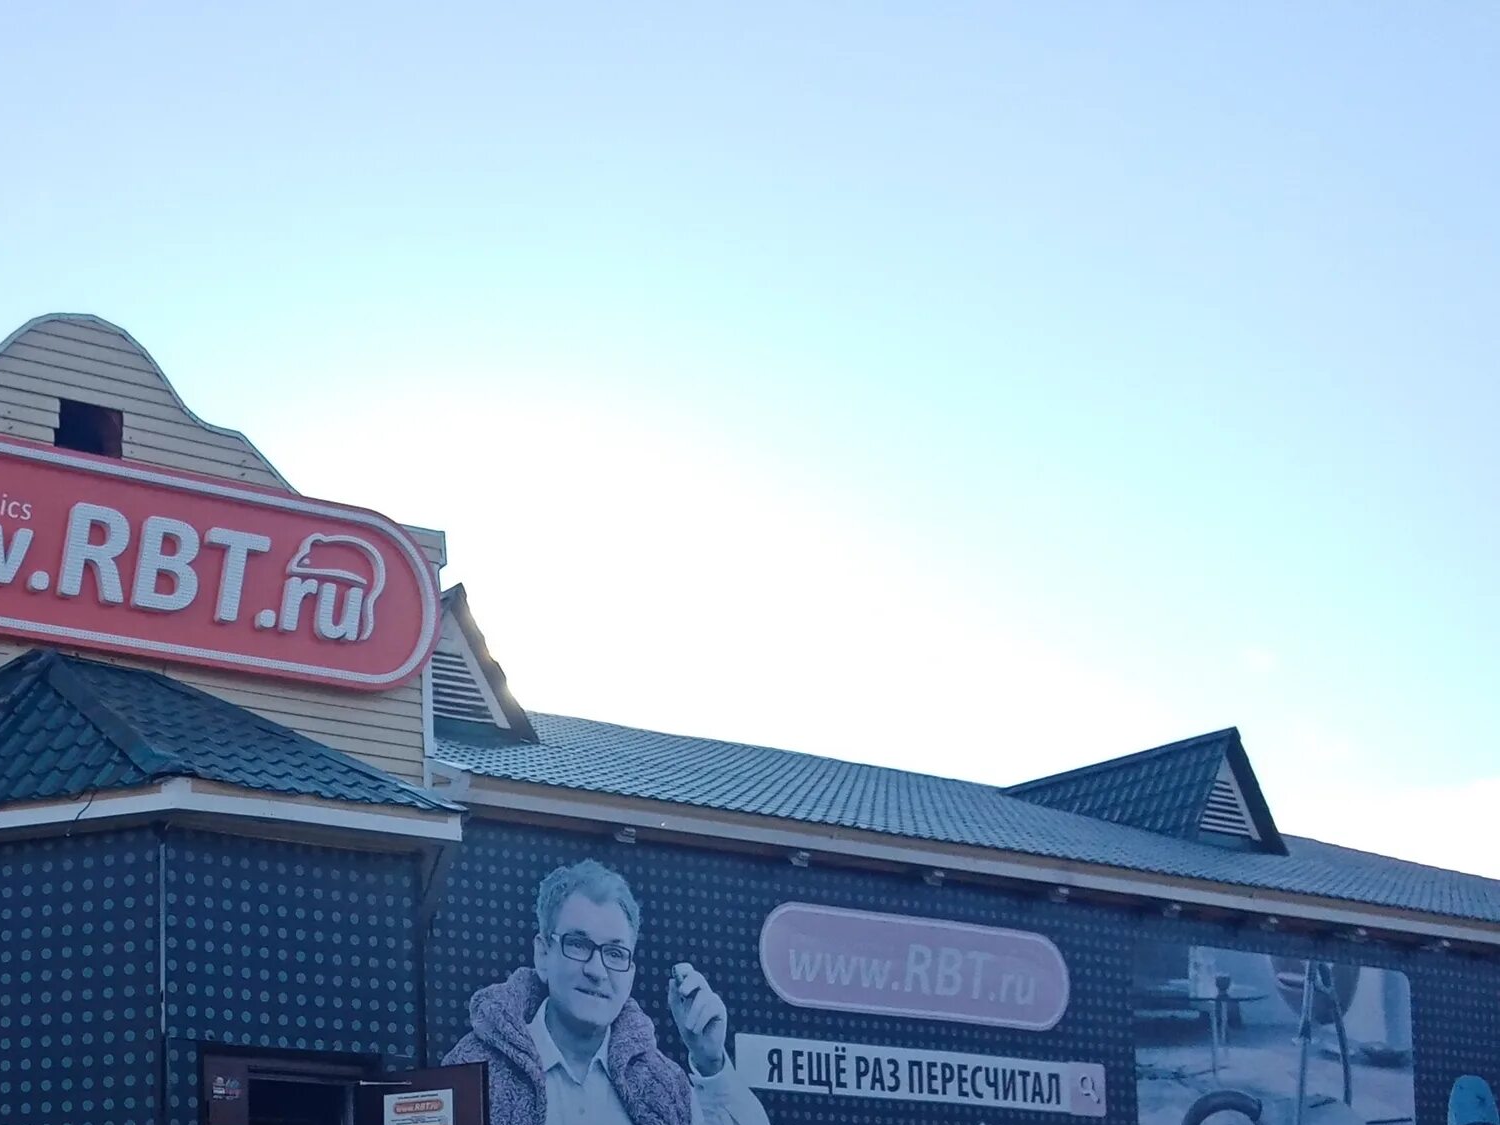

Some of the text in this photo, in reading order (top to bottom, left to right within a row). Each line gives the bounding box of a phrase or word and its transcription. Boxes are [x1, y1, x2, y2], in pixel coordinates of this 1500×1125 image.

[788, 943, 1036, 1006] www.RBT.ru
[766, 1045, 1061, 1106] Я ЕЩЁ РАЗ ПЕРЕСЧИТАЛ
